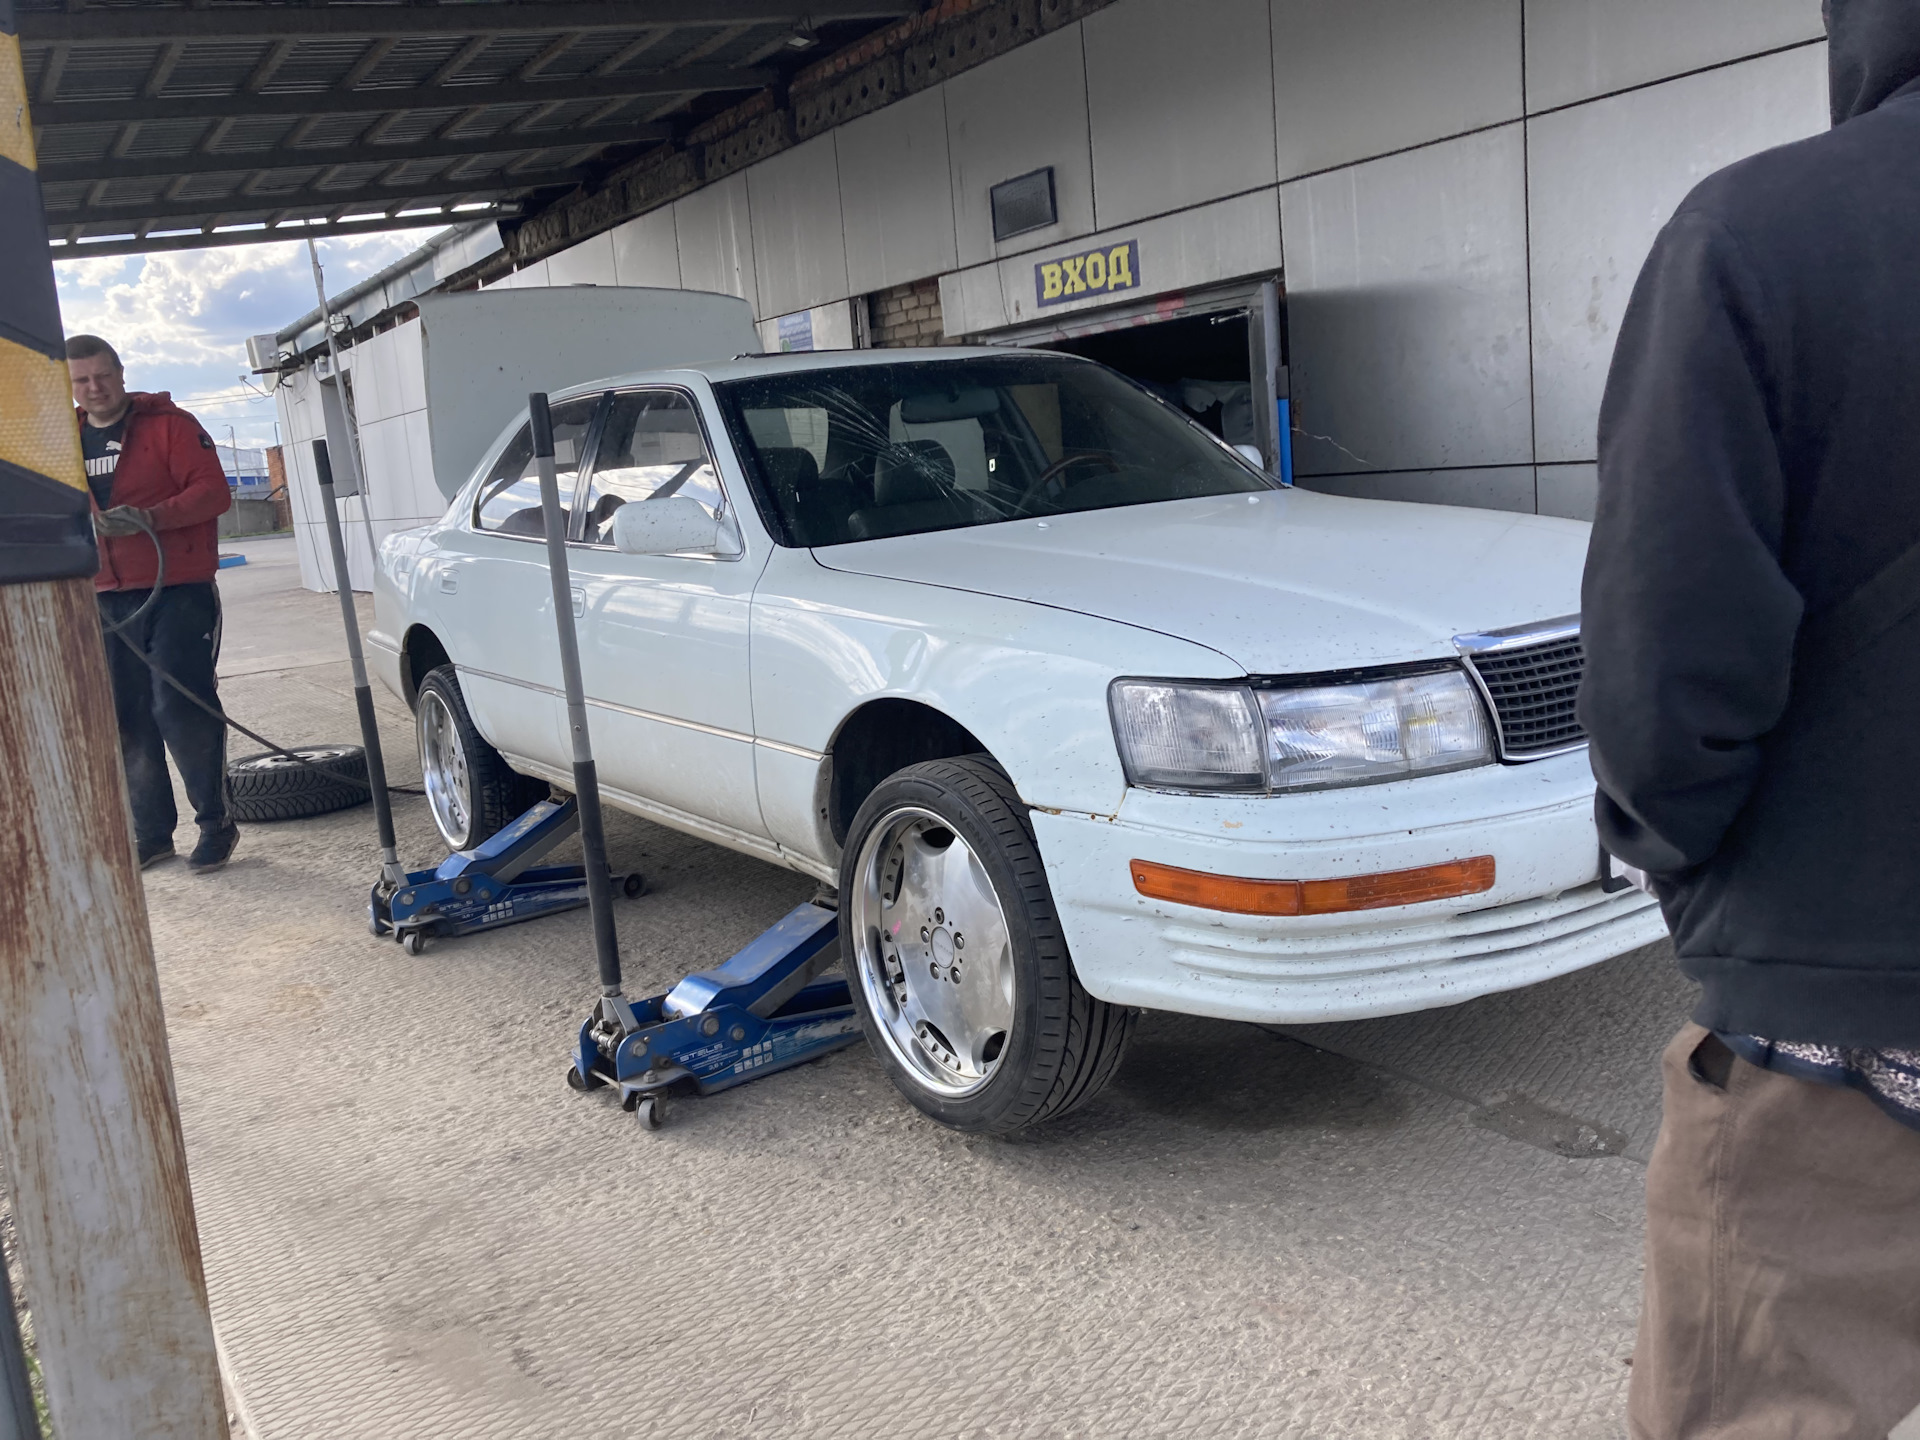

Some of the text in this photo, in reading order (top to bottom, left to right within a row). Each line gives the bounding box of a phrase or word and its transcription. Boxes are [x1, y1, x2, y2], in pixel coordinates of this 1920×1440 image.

[1041, 245, 1132, 299] ВХОД
[85, 454, 120, 476] UM
[680, 1043, 723, 1062] STELS
